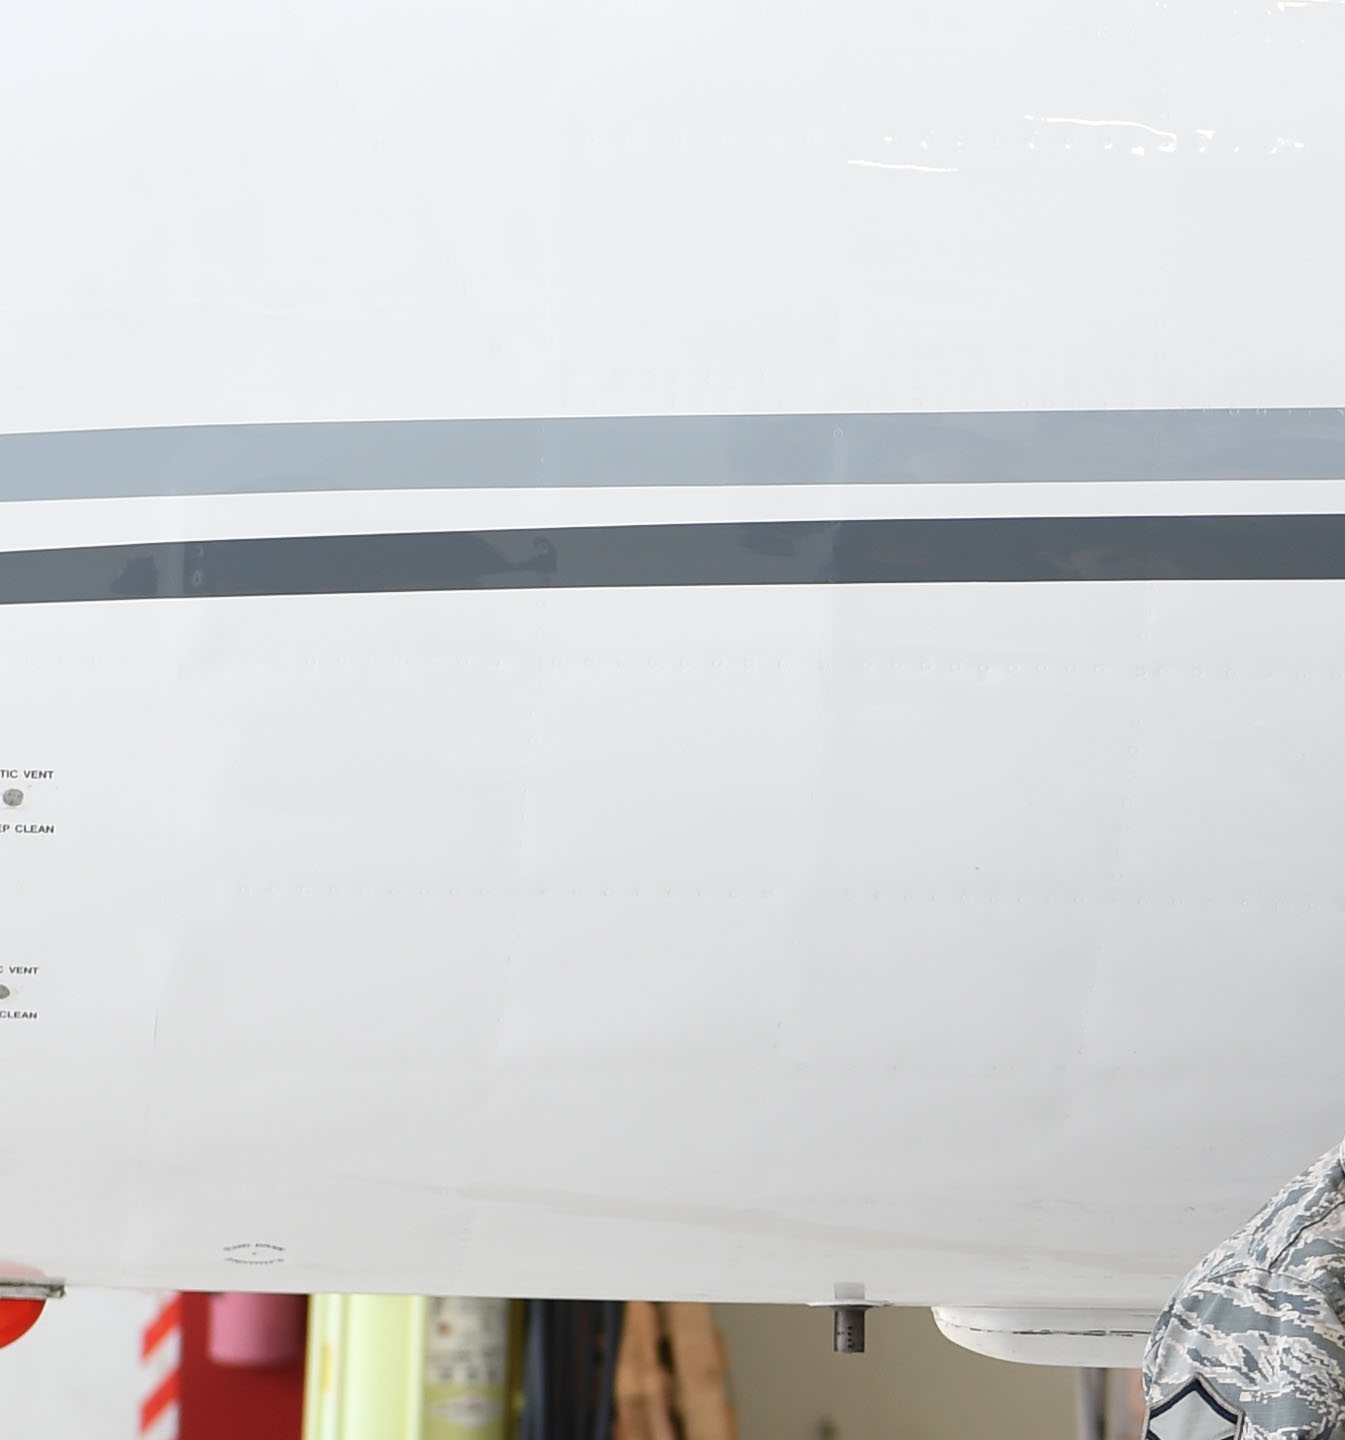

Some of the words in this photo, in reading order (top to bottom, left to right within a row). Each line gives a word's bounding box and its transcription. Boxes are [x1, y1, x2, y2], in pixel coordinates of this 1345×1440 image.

[0, 769, 18, 779] TIC
[23, 769, 55, 779] VENT
[14, 824, 55, 834] CLEAN
[9, 965, 40, 975] VENT
[0, 1010, 38, 1020] CLEAN
